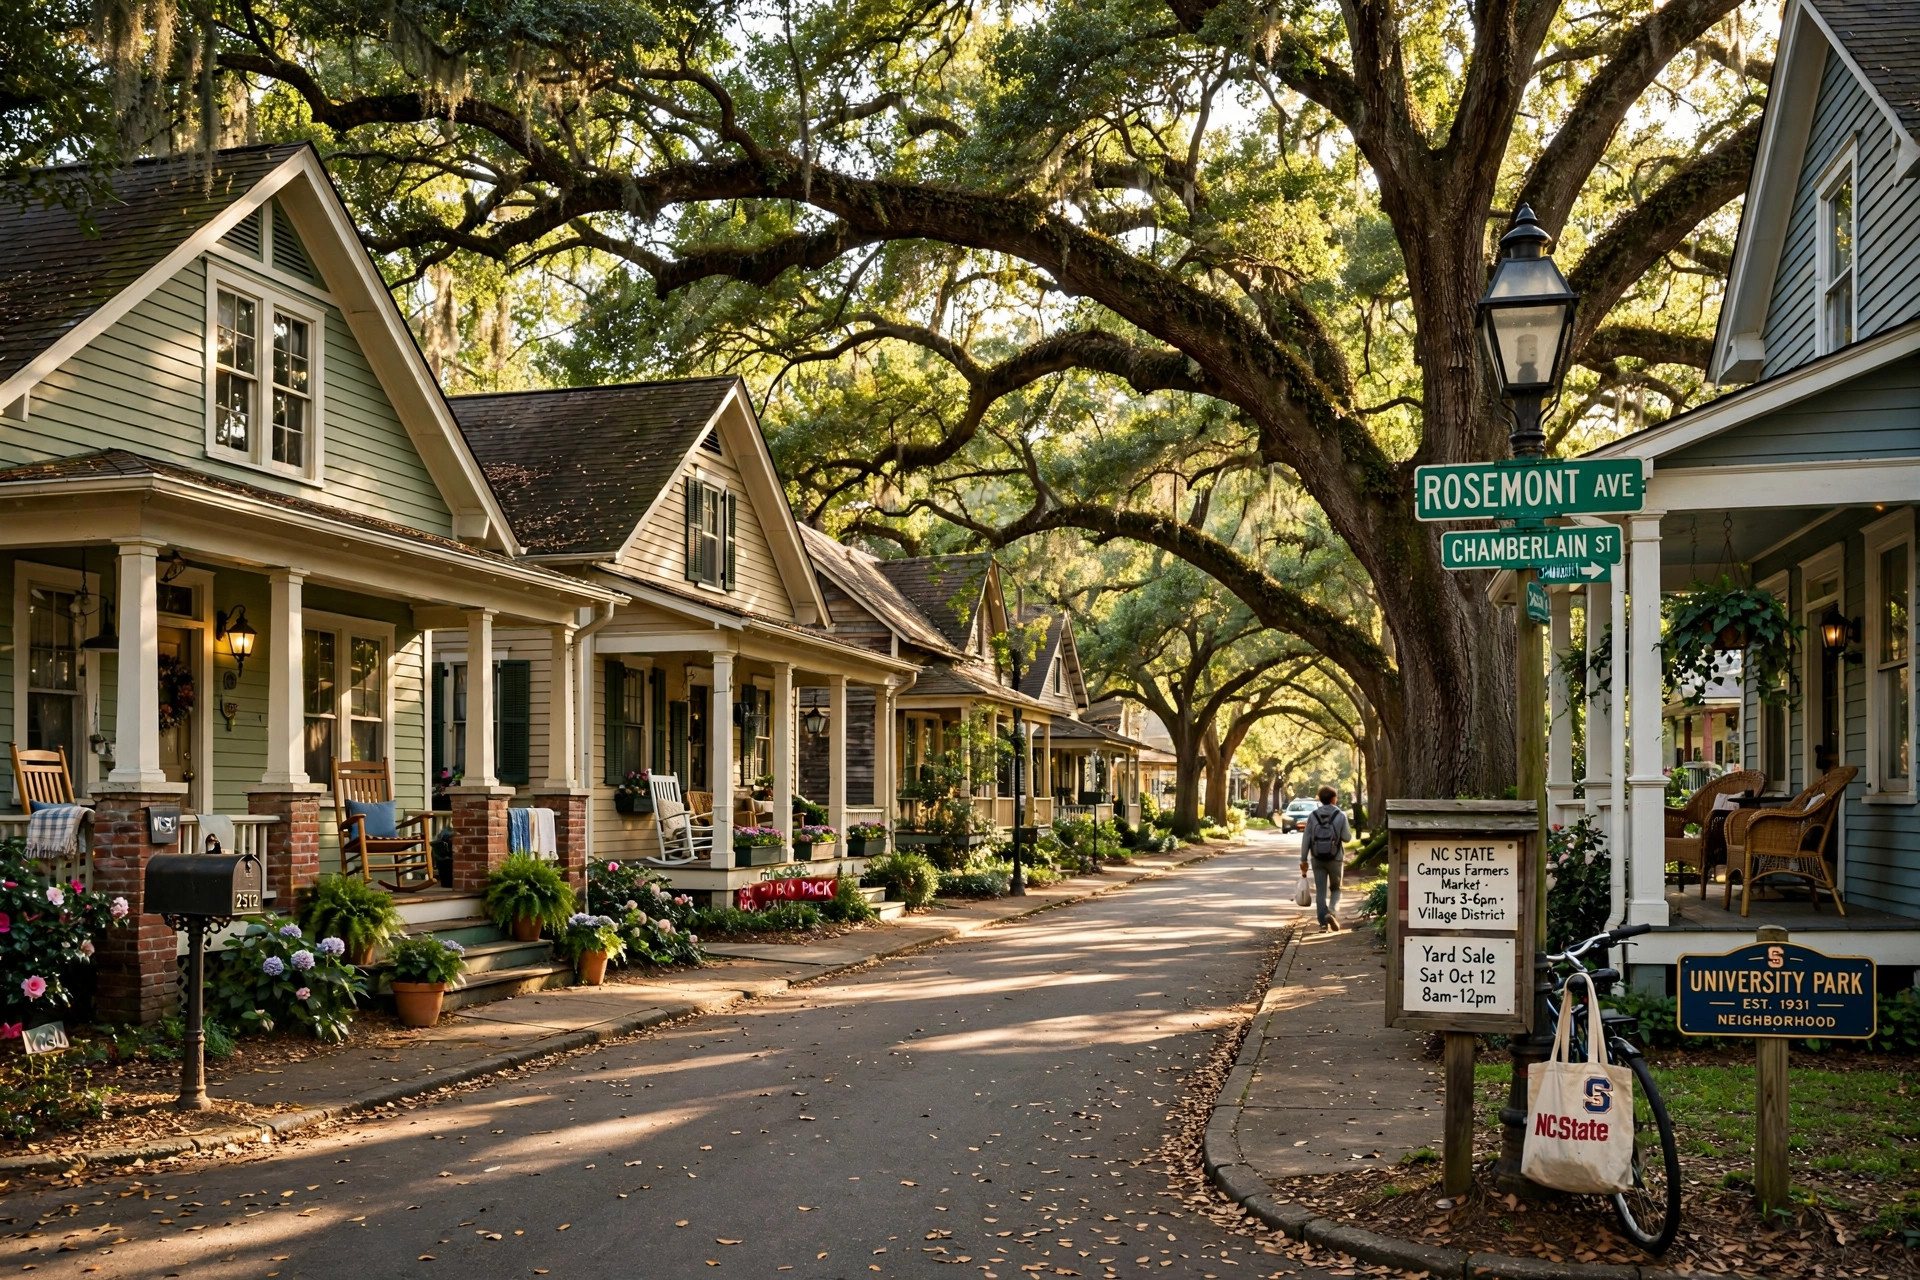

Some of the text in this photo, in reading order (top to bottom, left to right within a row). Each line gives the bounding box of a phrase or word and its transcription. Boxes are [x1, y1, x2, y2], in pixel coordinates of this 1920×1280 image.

[1424, 469, 1635, 511] ROSEMONT AVE
[1452, 534, 1613, 563] CHAMBERLAIN ST
[1431, 847, 1495, 861] NC STATE
[1417, 862, 1509, 879] Campus Farmers
[1441, 878, 1480, 890] Market
[1424, 892, 1497, 907] Thurs 3-6pm
[1418, 907, 1505, 924] Village District
[1422, 945, 1495, 964] Yard Sale
[1419, 967, 1496, 985] Sat Oct 12
[1690, 970, 1864, 995] UNIVERSITY PARK
[1422, 986, 1496, 1008] 8am-12pm
[1743, 999, 1809, 1010] EST. 1931
[1718, 1014, 1836, 1028] NEIGHBORHOOD
